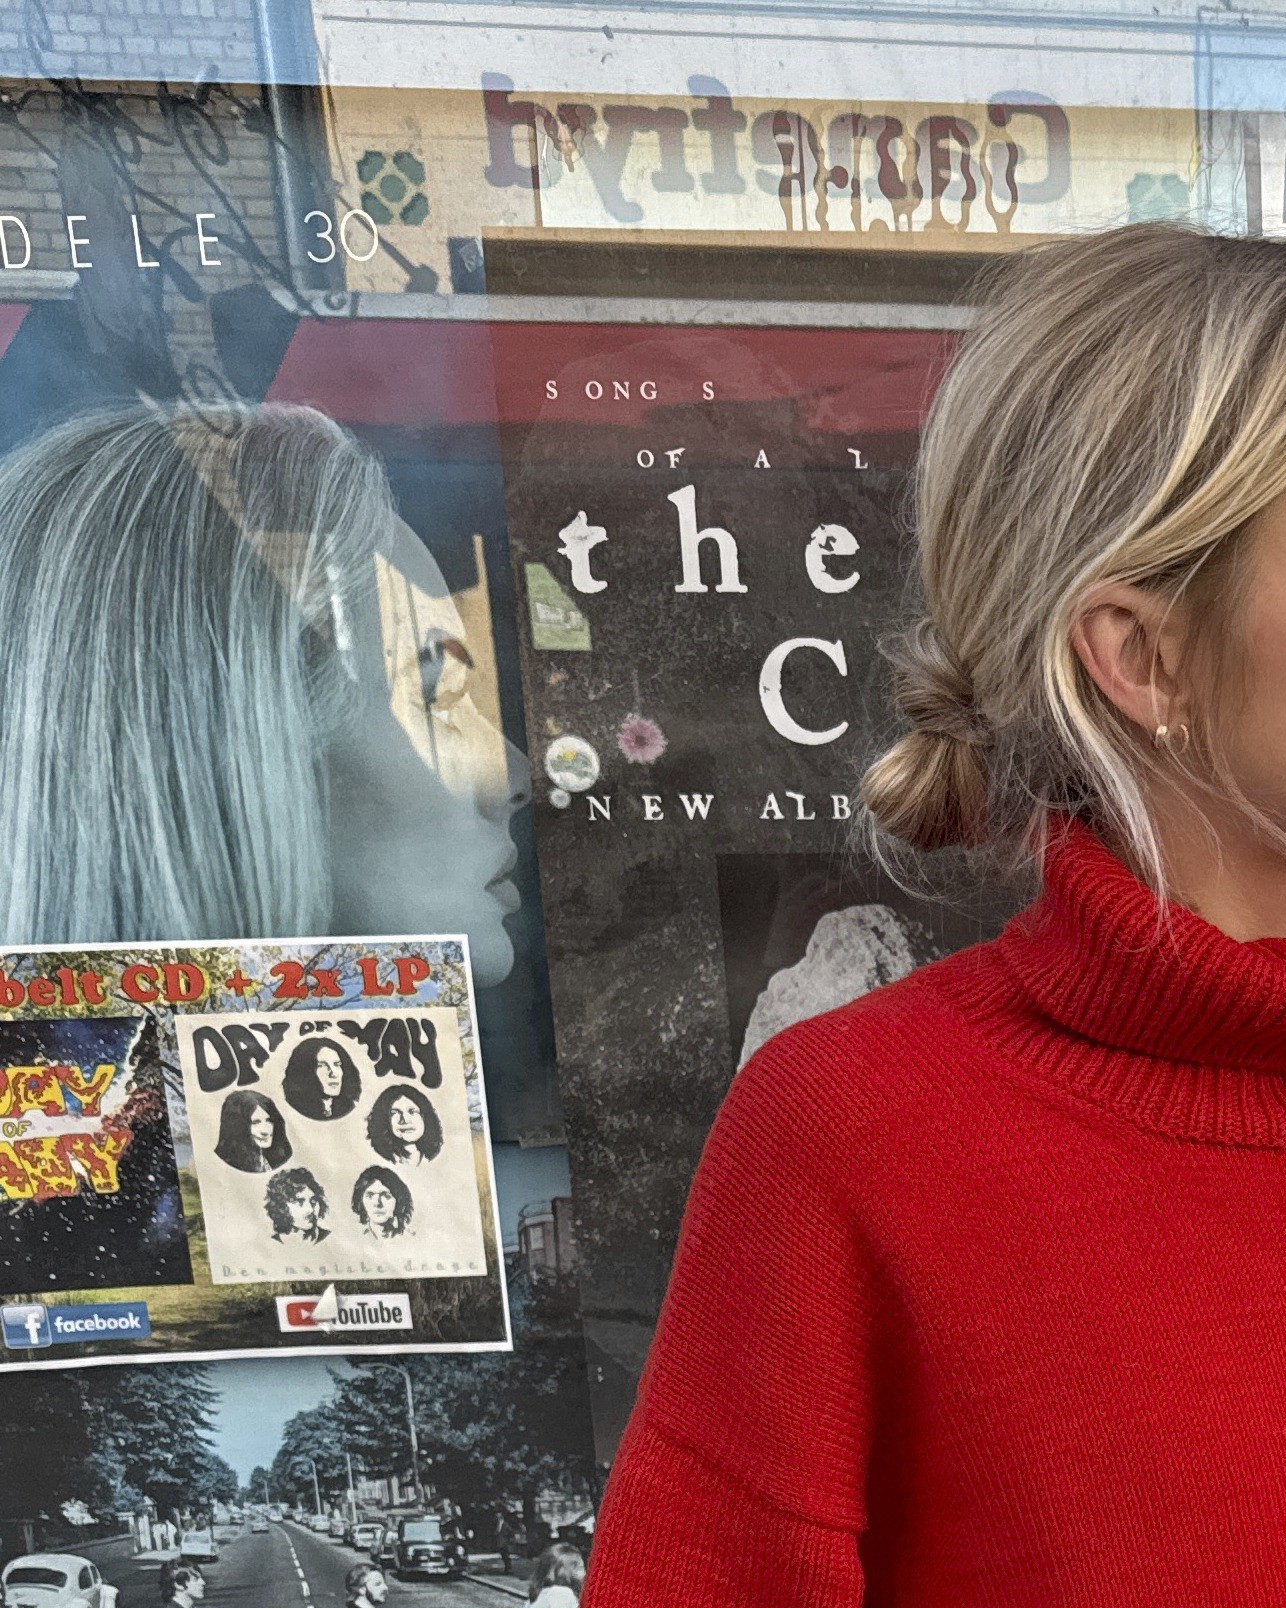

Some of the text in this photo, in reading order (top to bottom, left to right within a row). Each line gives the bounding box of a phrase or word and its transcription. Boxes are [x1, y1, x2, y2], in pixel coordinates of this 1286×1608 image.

[303, 208, 379, 262] 30
[636, 447, 772, 469] OF A
[557, 484, 861, 594] the
[588, 791, 852, 821] NEW ALB
[120, 963, 206, 1003] CD
[270, 960, 344, 999] 2x
[356, 955, 431, 996] LP
[192, 1022, 290, 1093] DAY
[299, 1020, 334, 1036] OF
[2, 1121, 32, 1139] OF
[54, 1312, 141, 1334] facebook
[332, 1301, 403, 1326] ouTube
